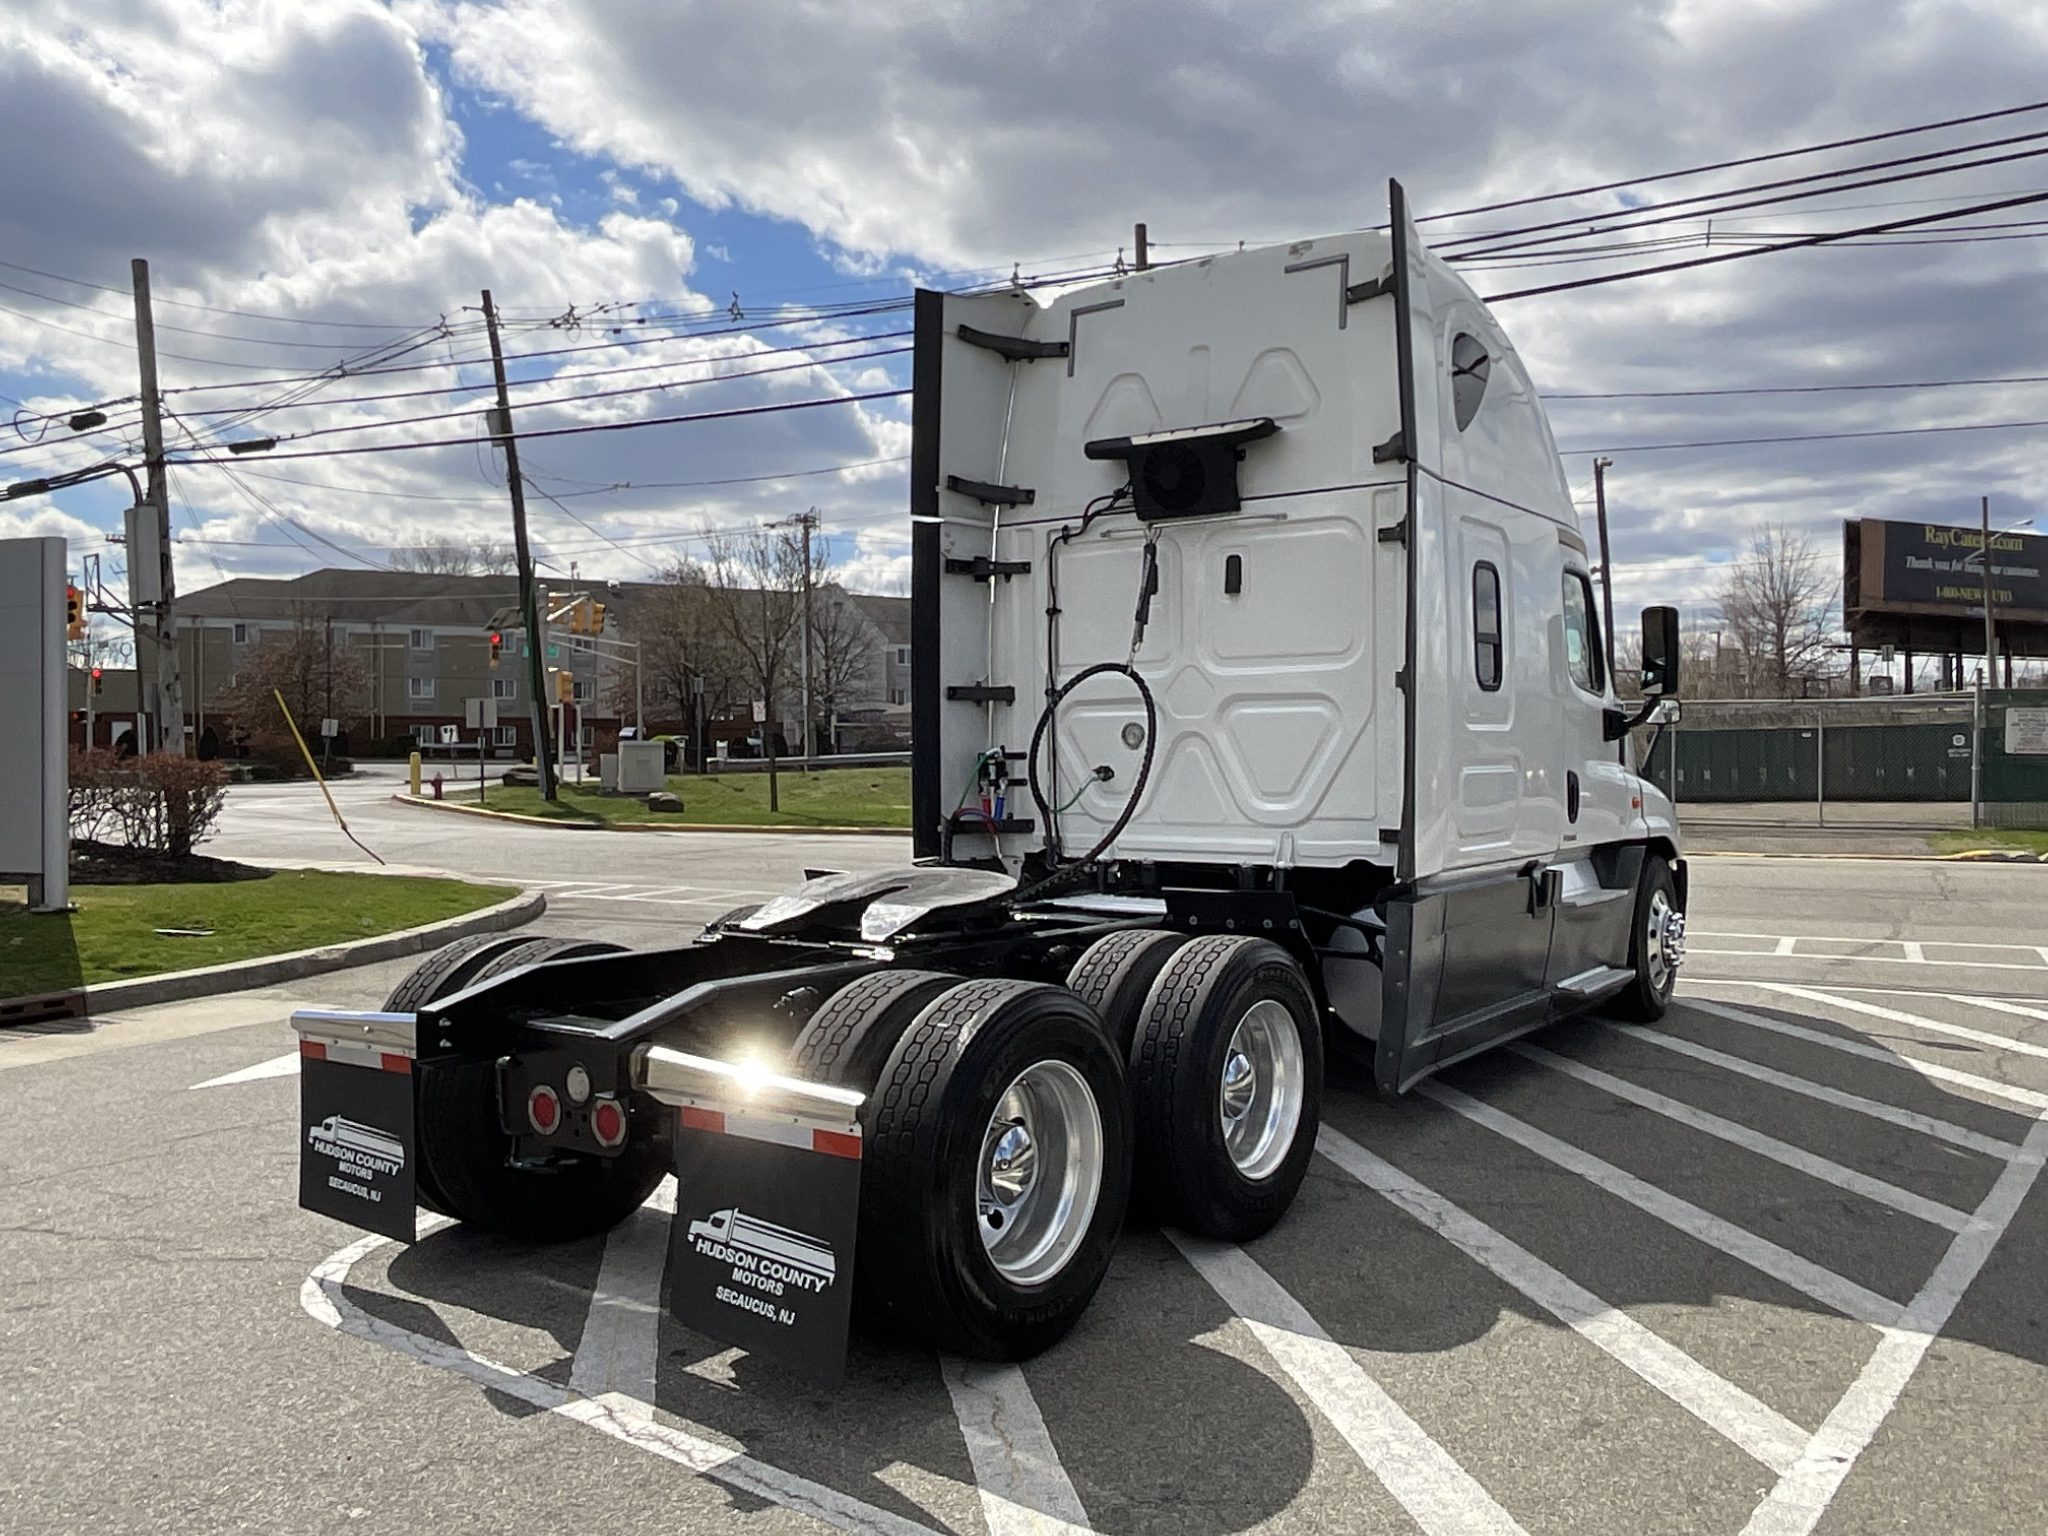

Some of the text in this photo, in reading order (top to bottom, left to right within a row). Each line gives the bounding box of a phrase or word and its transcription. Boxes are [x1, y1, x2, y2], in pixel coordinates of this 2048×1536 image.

[1924, 525, 2024, 551] RayCate.com
[314, 1140, 400, 1177] HUDSON COUNTY
[338, 1160, 373, 1180] MOTORS
[328, 1176, 382, 1202] SECAUCUS, NJ
[695, 1238, 827, 1293] HUDSON COUNTY
[731, 1267, 784, 1296] MOTORS
[715, 1285, 796, 1325] SECAUCUS, NJ
